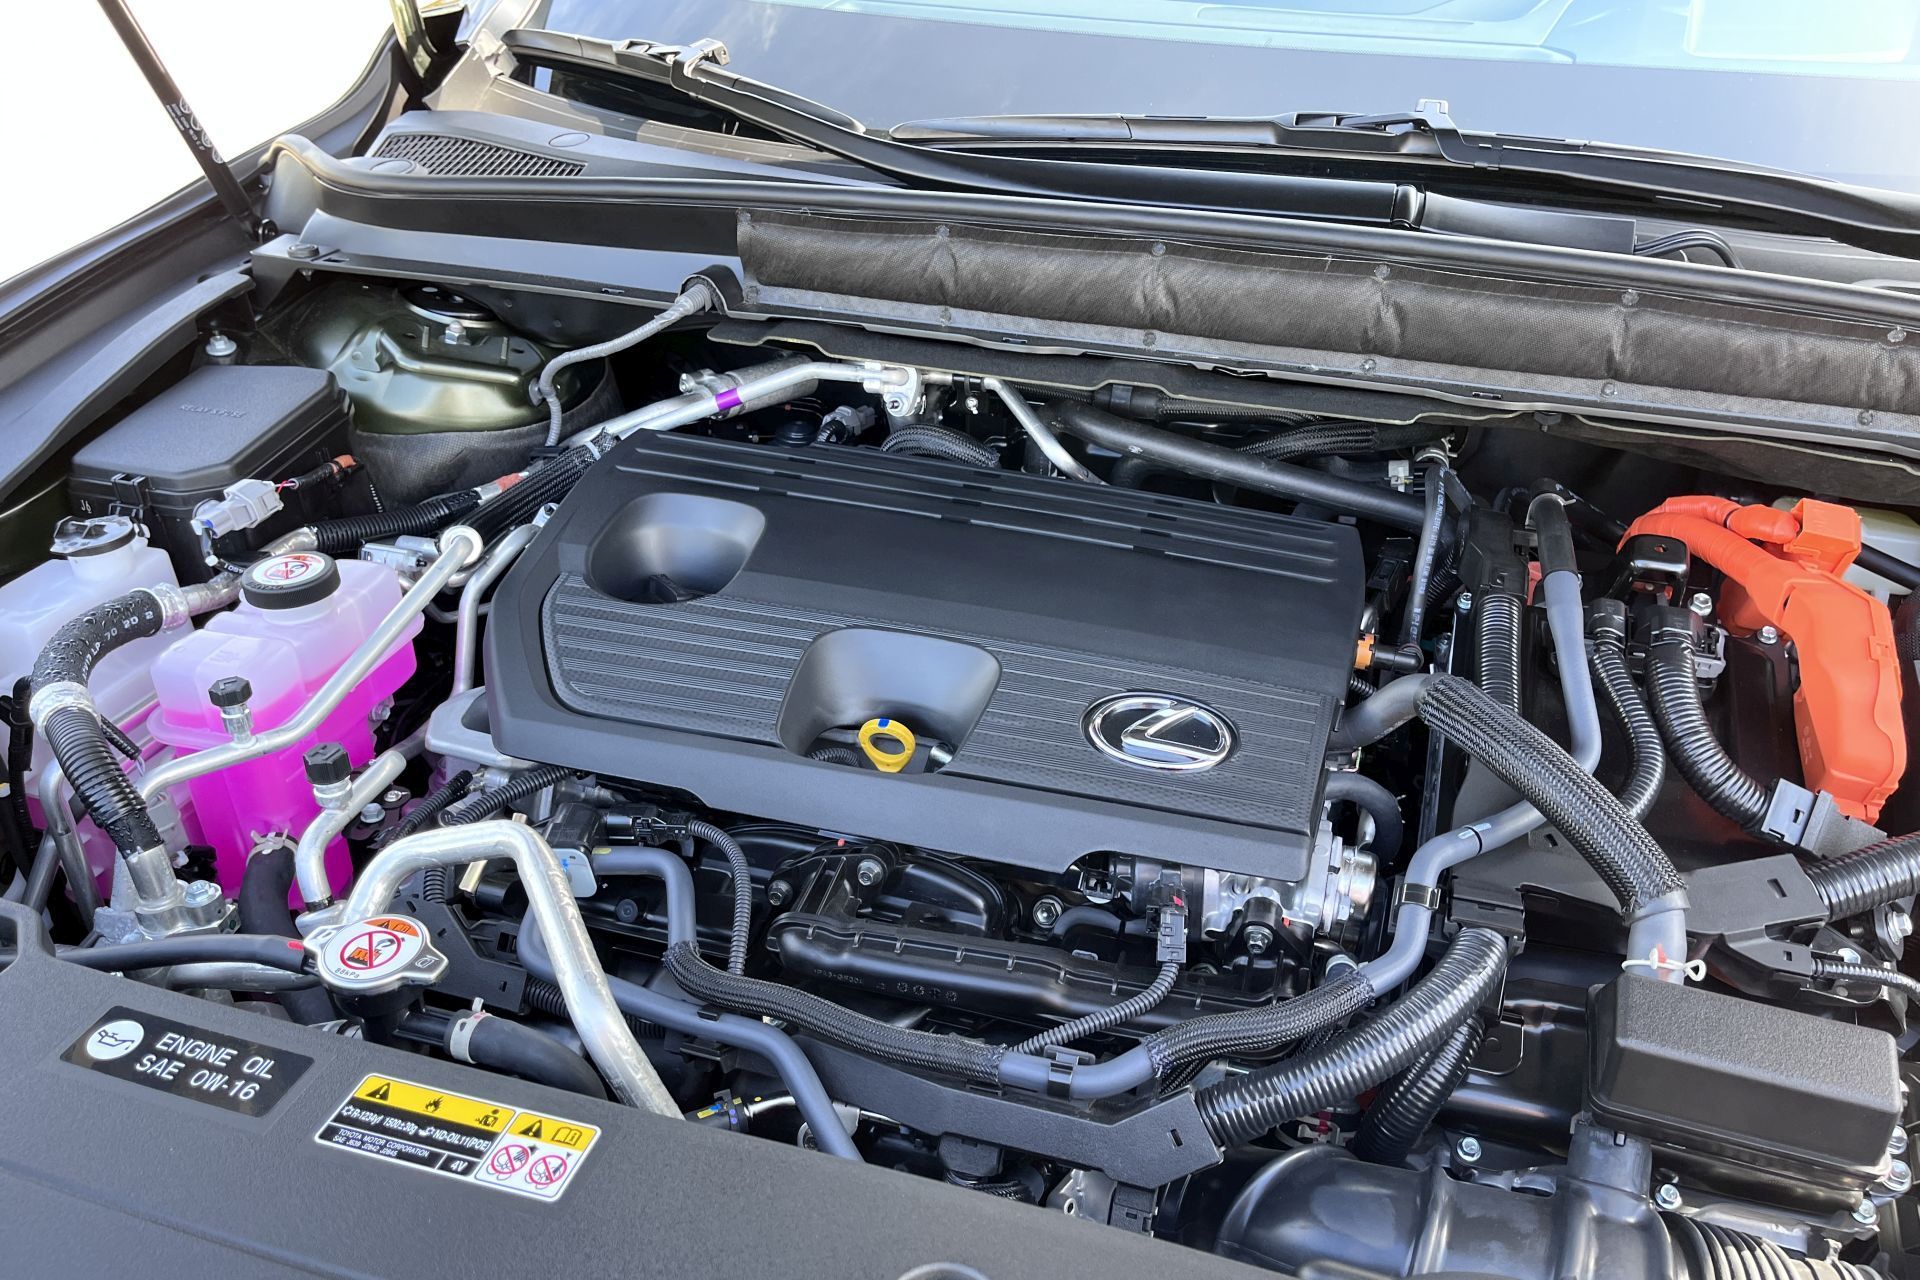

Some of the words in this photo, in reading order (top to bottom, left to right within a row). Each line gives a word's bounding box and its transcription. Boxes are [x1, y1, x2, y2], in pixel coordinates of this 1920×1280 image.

[135, 1054, 186, 1081] SAE
[155, 1032, 239, 1068] ENGINE
[242, 1056, 276, 1079] OIL
[333, 1134, 347, 1144] SAE
[338, 1128, 362, 1140] TOYOTA
[362, 1135, 387, 1146] MOTOR
[386, 1141, 430, 1158] CORPORATION
[450, 1160, 468, 1172] 4V
